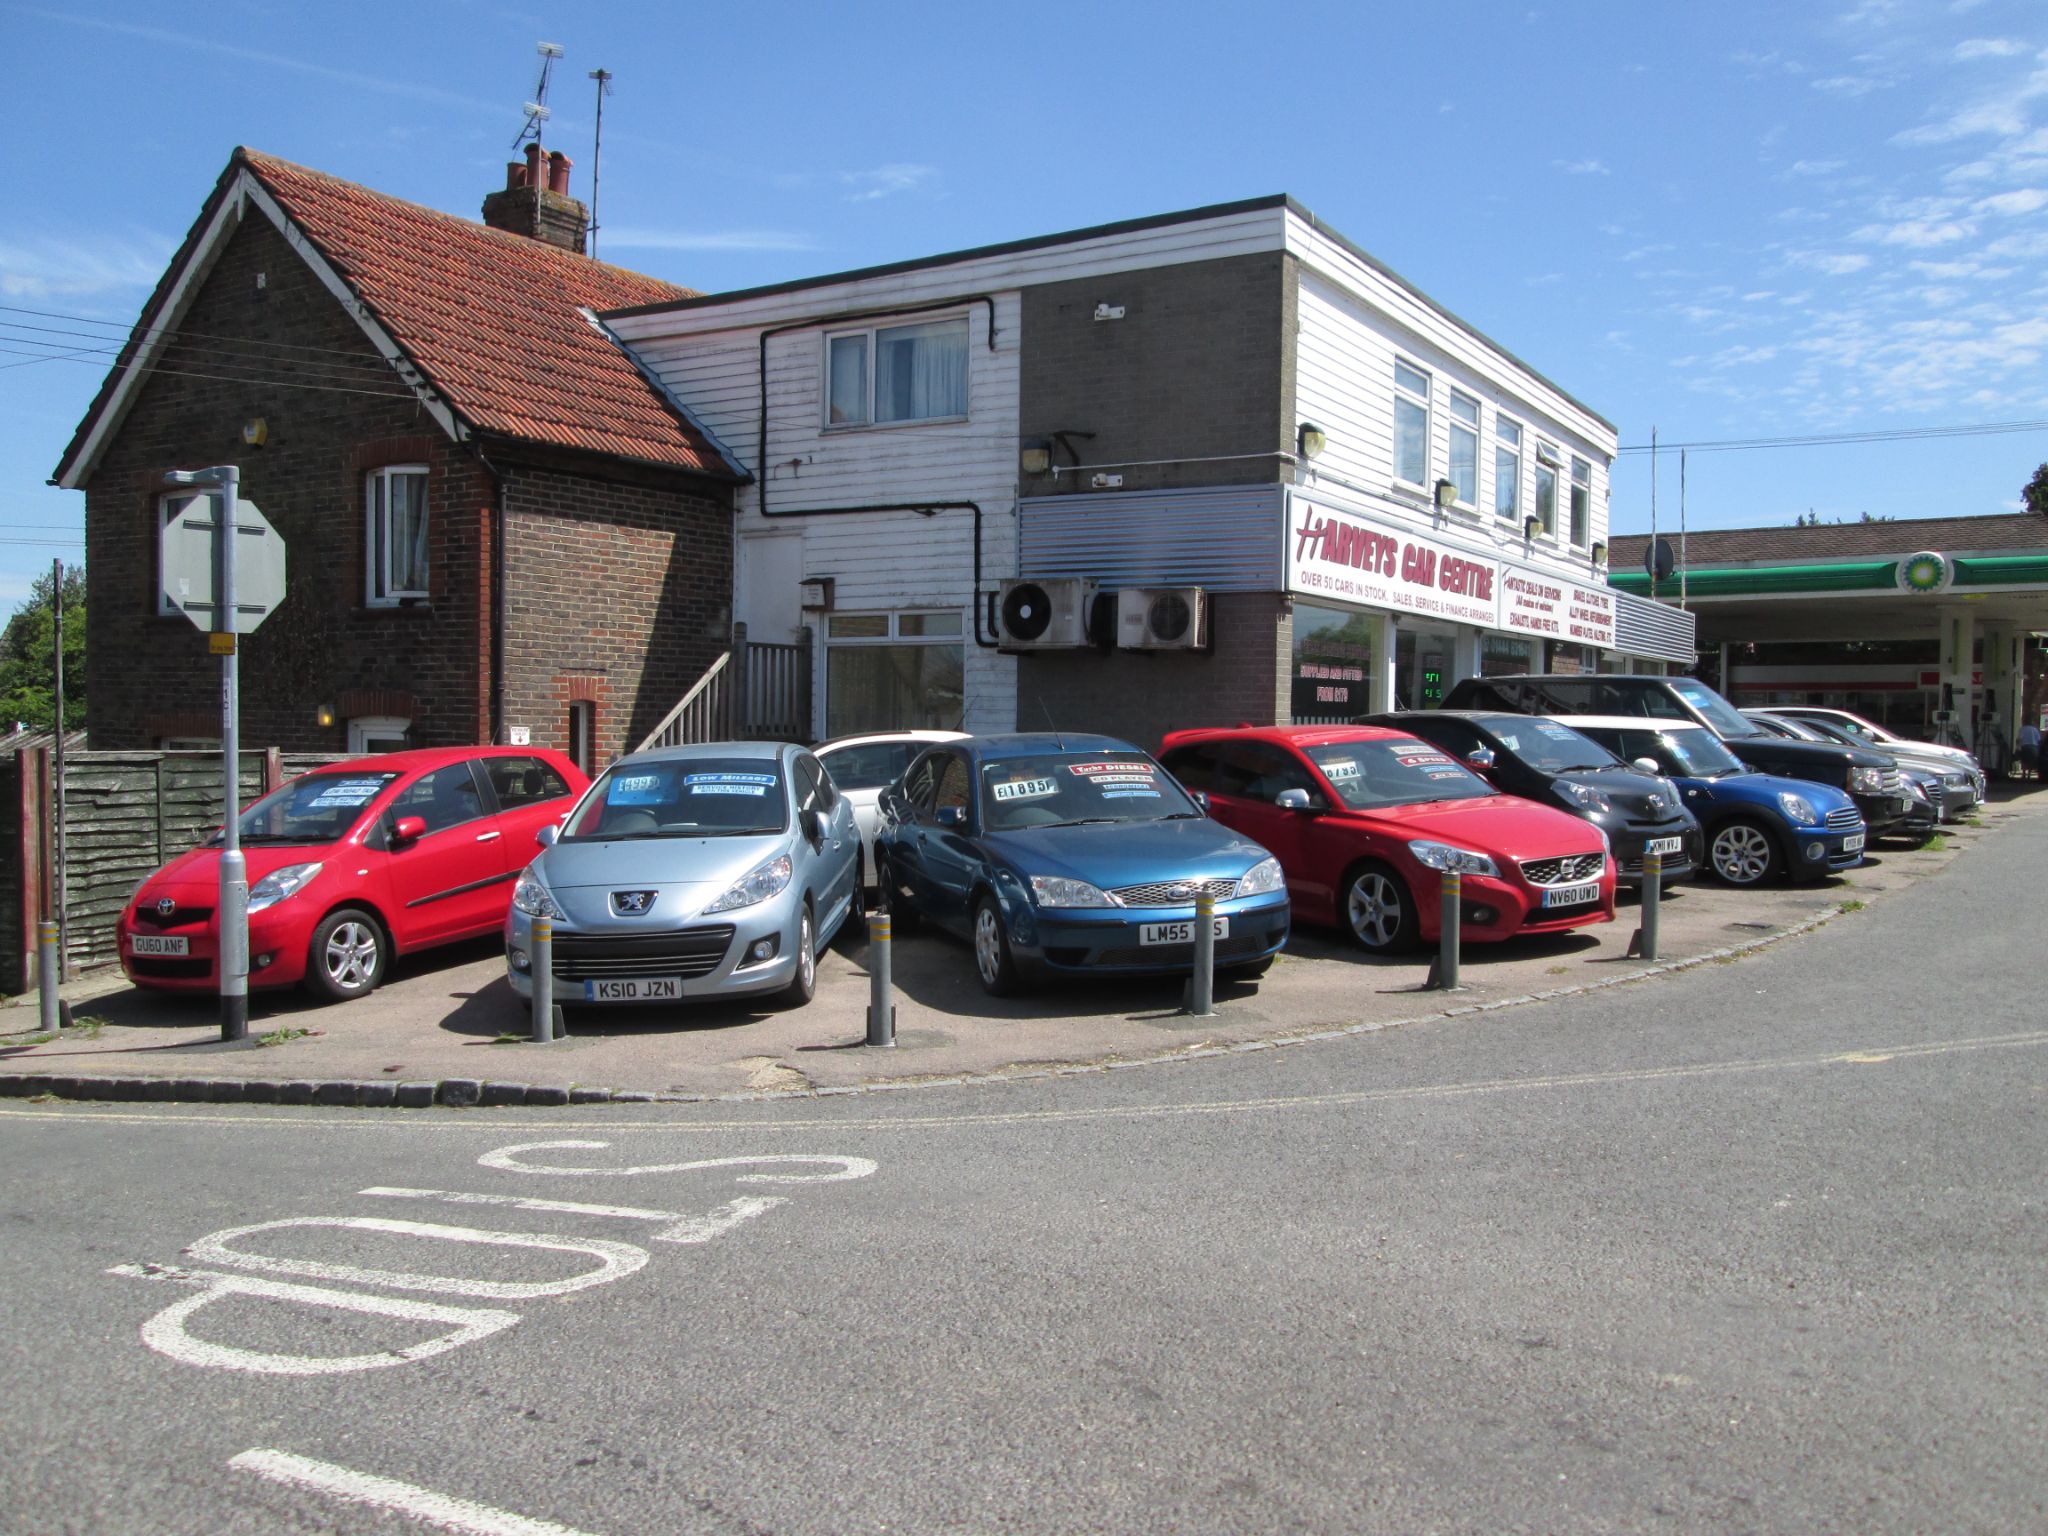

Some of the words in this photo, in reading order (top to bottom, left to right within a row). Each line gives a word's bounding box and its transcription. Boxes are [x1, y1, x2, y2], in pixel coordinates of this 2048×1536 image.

[1296, 504, 1398, 578] HARVEYS
[1401, 543, 1437, 588] CAR
[1439, 554, 1494, 602] CENTRE
[1301, 571, 1322, 587] OVER
[1324, 576, 1333, 590] 50
[1335, 578, 1354, 594] CARS
[1356, 583, 1363, 596] IN
[1415, 596, 1440, 612] SERVICE
[1441, 602, 1445, 613] &
[1446, 603, 1468, 618] FINANCE
[1469, 608, 1494, 623] ARRANGED
[1106, 763, 1149, 772] DIESEL
[1550, 888, 1577, 905] NV60
[1579, 885, 1598, 900] UWD
[1147, 924, 1188, 942] LM55
[136, 938, 161, 953] GU60
[164, 939, 184, 953] ANF
[599, 982, 637, 998] KS10
[643, 981, 675, 997] JZN
